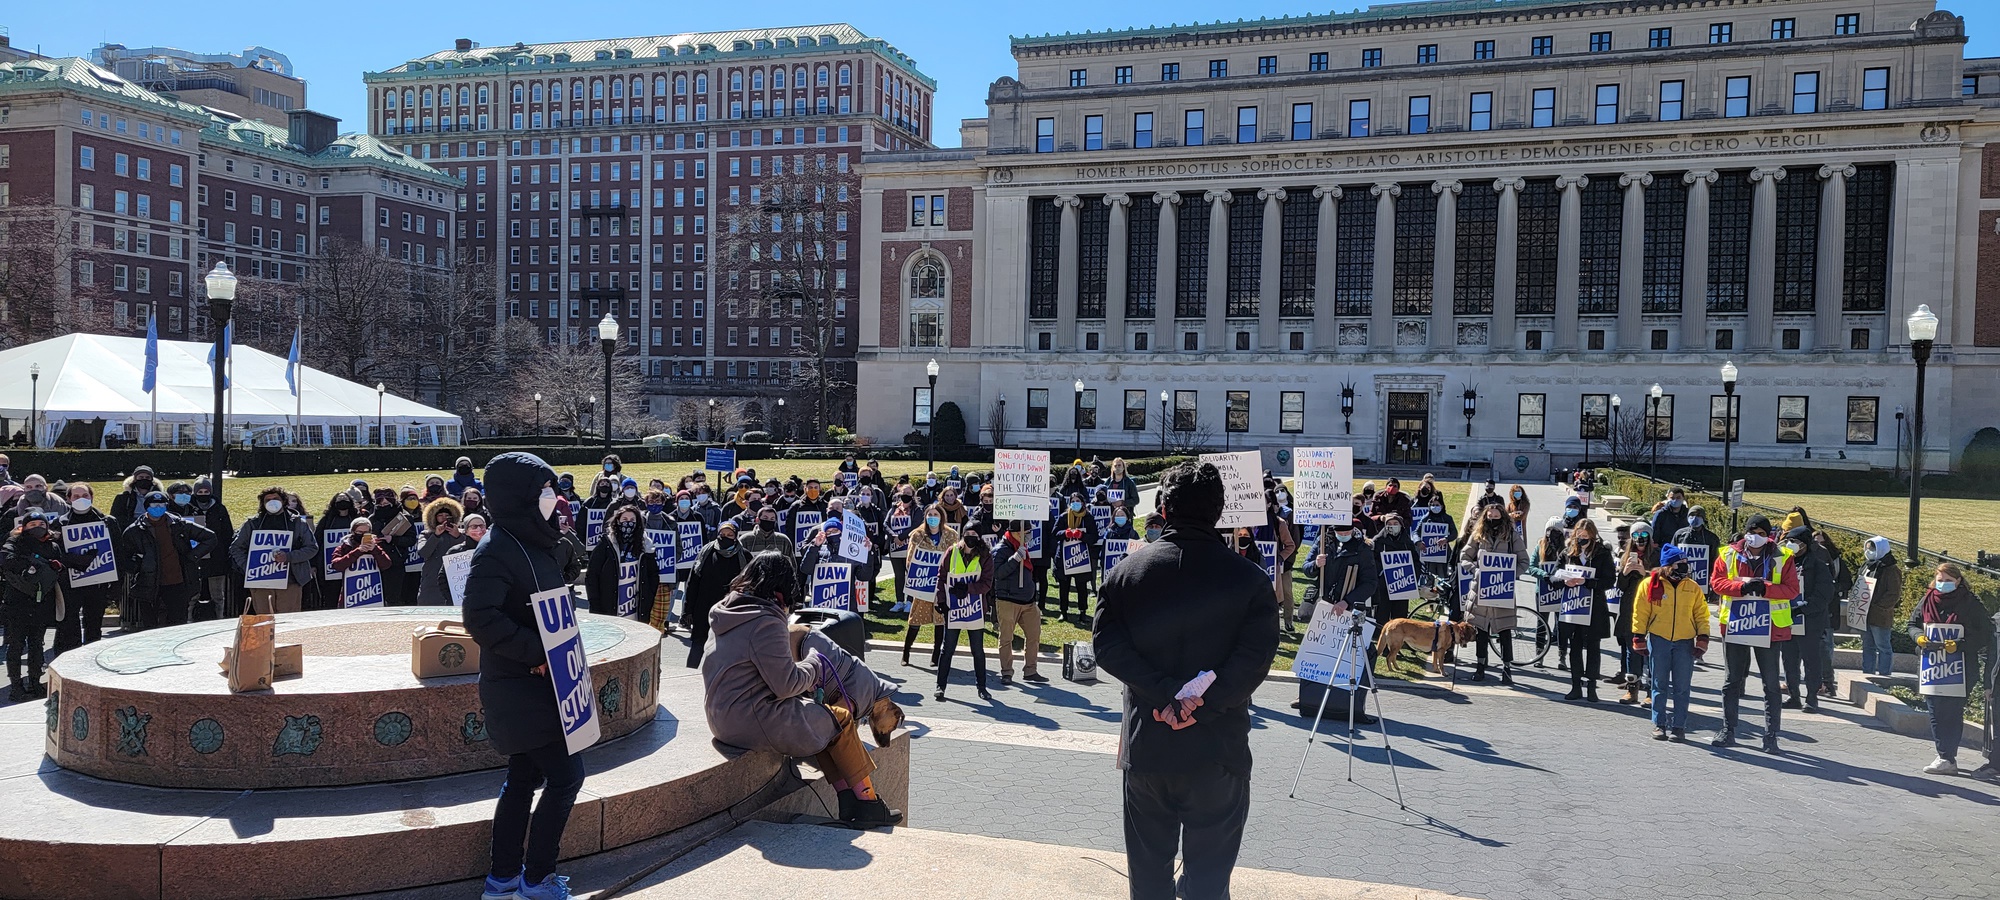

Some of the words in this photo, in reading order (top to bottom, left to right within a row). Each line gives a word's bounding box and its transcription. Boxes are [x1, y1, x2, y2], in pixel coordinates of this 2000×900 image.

[1077, 167, 1126, 179] HOMER
[1137, 162, 1229, 177] HERODOTUS
[1241, 158, 1333, 172] SOPHOCLES
[1346, 154, 1400, 168] PLATO
[1415, 149, 1508, 164] ARISTOTLE
[1521, 141, 1654, 159] DEMOSTHENES
[1669, 138, 1740, 152] CICERO
[1756, 134, 1826, 148] VERGIL
[998, 461, 1015, 470] SHUT
[1298, 460, 1335, 469] COLUMBIA
[997, 473, 1030, 483] VICTORY
[1034, 474, 1043, 483] TO
[1299, 470, 1332, 479] AMAZON
[997, 483, 1013, 492] THE
[1231, 483, 1251, 491] WASH
[1297, 481, 1317, 489] FIRED
[1320, 482, 1339, 490] WASH
[1234, 491, 1263, 501] LAUNDRY
[1296, 491, 1320, 500] SUPPLY
[1323, 491, 1352, 502] LAUNDRY
[1297, 501, 1334, 510] WORKERS
[798, 513, 820, 524] UAW
[1092, 508, 1109, 517] UAW
[67, 524, 105, 542] UAW
[1424, 524, 1446, 534] UAW
[254, 533, 289, 546] UAW
[847, 532, 864, 544] NOW
[1070, 543, 1081, 555] ON
[1108, 541, 1128, 551] UAW
[914, 549, 941, 564] UAW
[1065, 550, 1088, 569] STRIKE
[1384, 553, 1409, 565] UAW
[1483, 555, 1514, 568] UAW
[348, 557, 377, 571] UAW
[247, 562, 288, 580] STRIKE
[817, 567, 848, 580] UAW
[916, 567, 929, 578] ON
[1393, 567, 1405, 580] ON
[356, 575, 371, 590] ON
[906, 576, 939, 588] STRIKE
[1388, 574, 1415, 594] STRIKE
[1489, 572, 1503, 585] ON
[346, 583, 382, 607] STRIKE
[822, 584, 837, 600] ON
[1480, 581, 1514, 599] STRIKE
[1568, 586, 1580, 599] ON
[1561, 596, 1591, 614] STRIKE
[1740, 601, 1757, 617] ON
[1855, 581, 1874, 625] HONK
[950, 599, 982, 621] STRIKE
[1317, 619, 1327, 631] TO
[1331, 625, 1348, 638] THE
[1727, 613, 1771, 633] STRIKE
[1306, 630, 1326, 646] GWC
[1928, 648, 1946, 665] ON
[1301, 660, 1319, 669] CUNY
[1299, 672, 1319, 681] CLUBS
[1921, 661, 1962, 684] STRIKE
